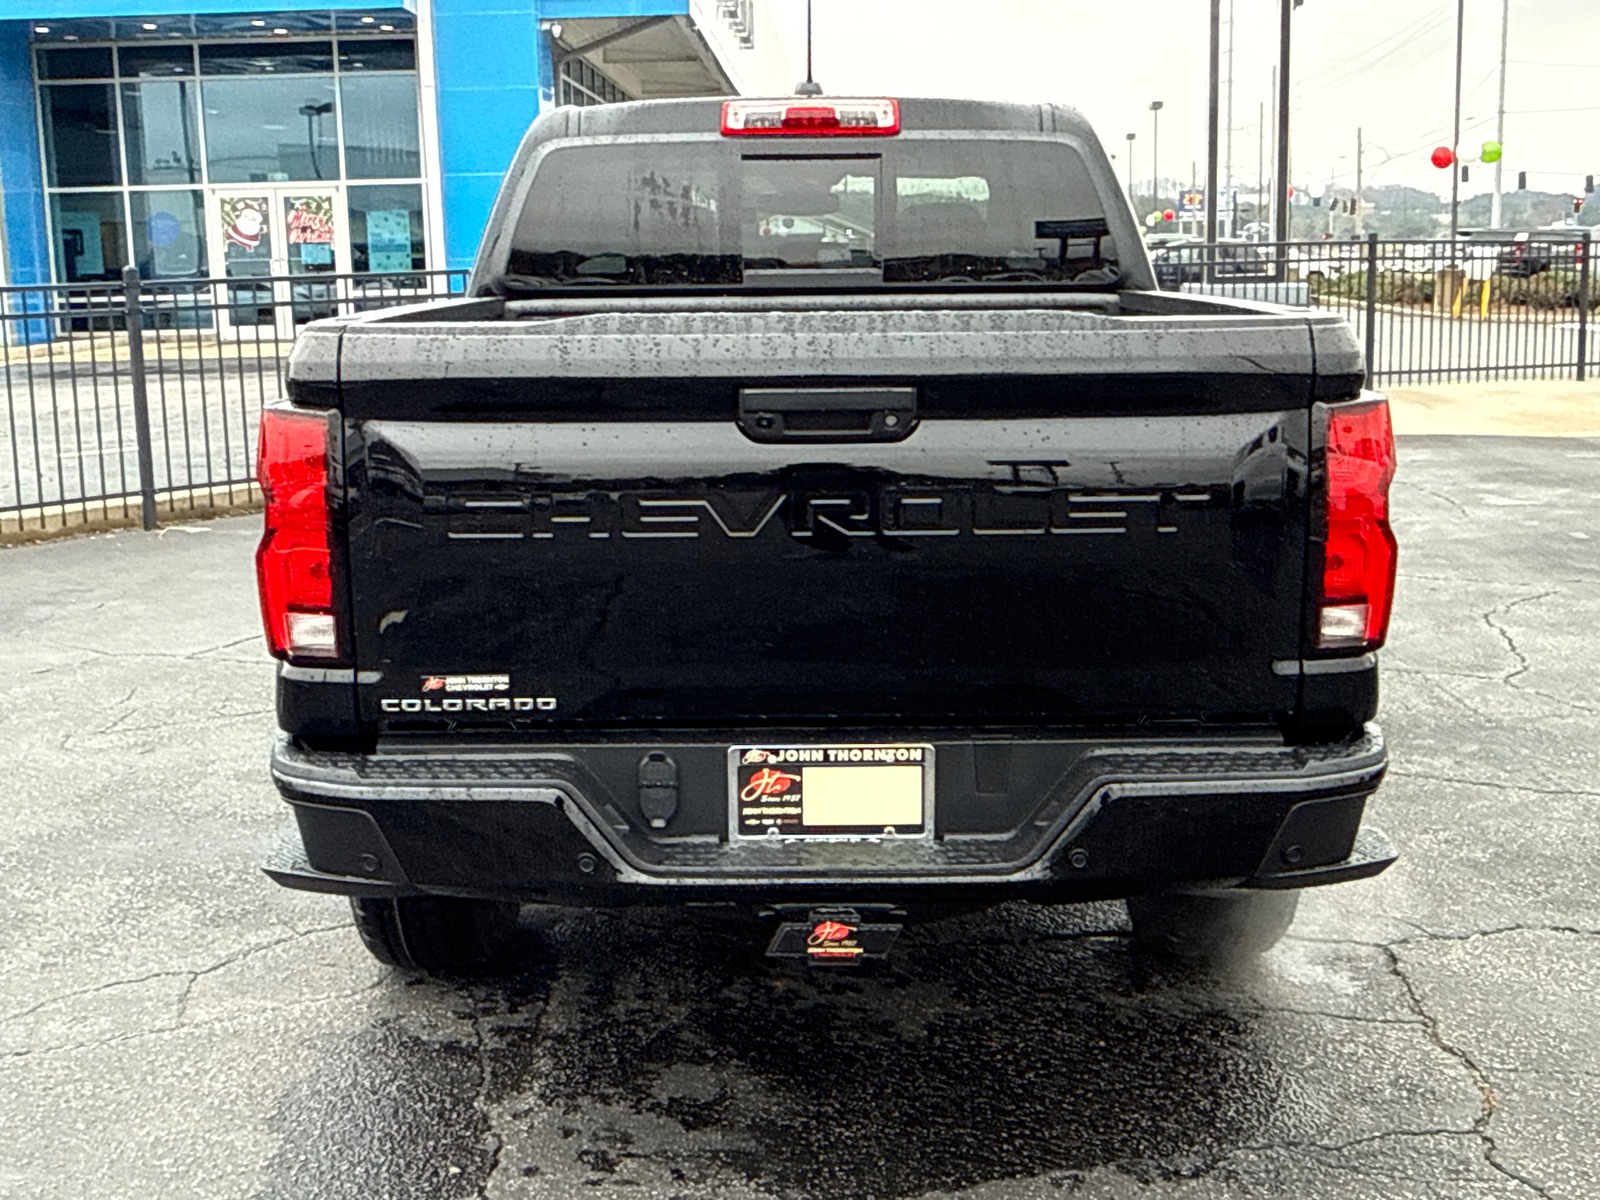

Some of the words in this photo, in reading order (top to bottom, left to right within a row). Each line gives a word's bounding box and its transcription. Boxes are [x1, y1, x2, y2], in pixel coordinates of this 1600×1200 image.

[446, 494, 1211, 537] CHEVROLET
[381, 698, 557, 712] COLORADO
[776, 750, 823, 762] JOHN
[827, 749, 922, 762] THORNTON
